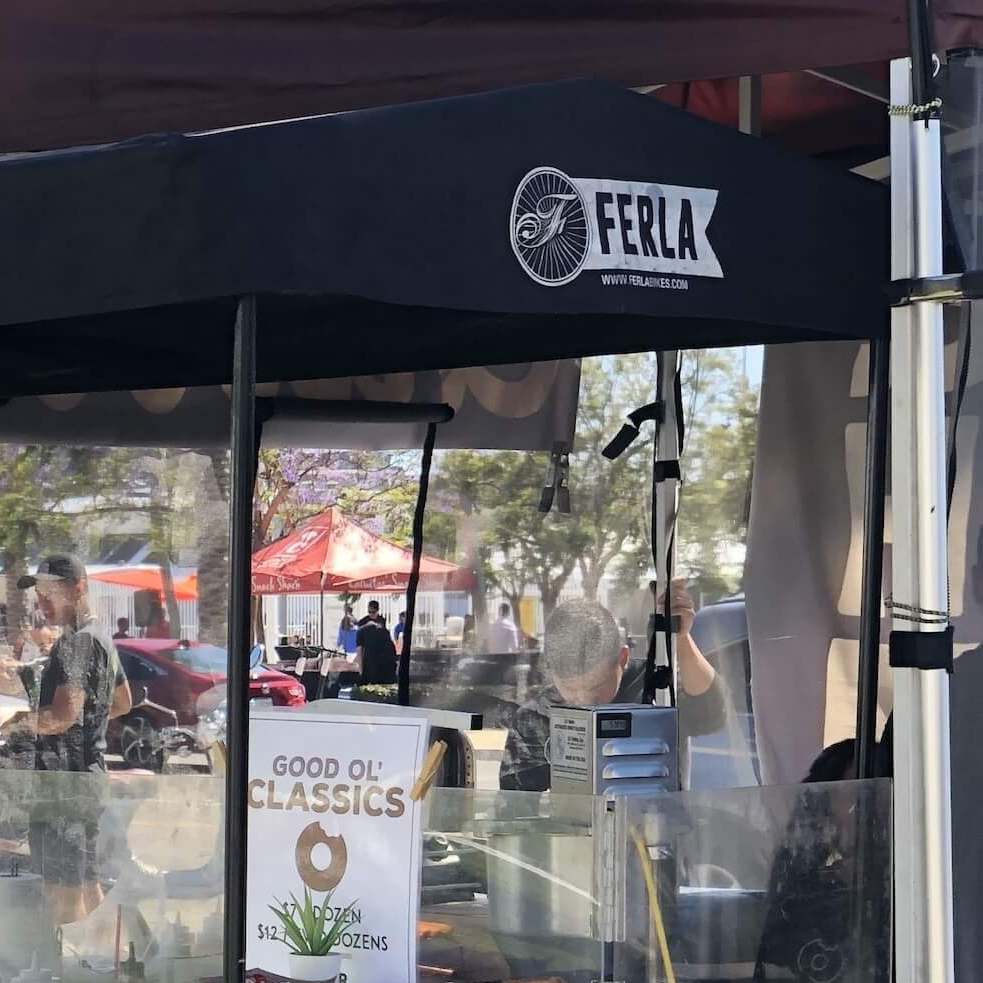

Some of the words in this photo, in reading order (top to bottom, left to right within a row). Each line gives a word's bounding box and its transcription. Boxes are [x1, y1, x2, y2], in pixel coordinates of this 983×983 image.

[595, 191, 699, 261] FERLA
[601, 274, 689, 291] WWW.FERLABIKES.COM
[272, 755, 340, 779] GOOD
[348, 759, 383, 781] OL'
[247, 778, 405, 818] CLASSICS
[313, 905, 362, 924] DOZEN
[257, 923, 277, 940] $12
